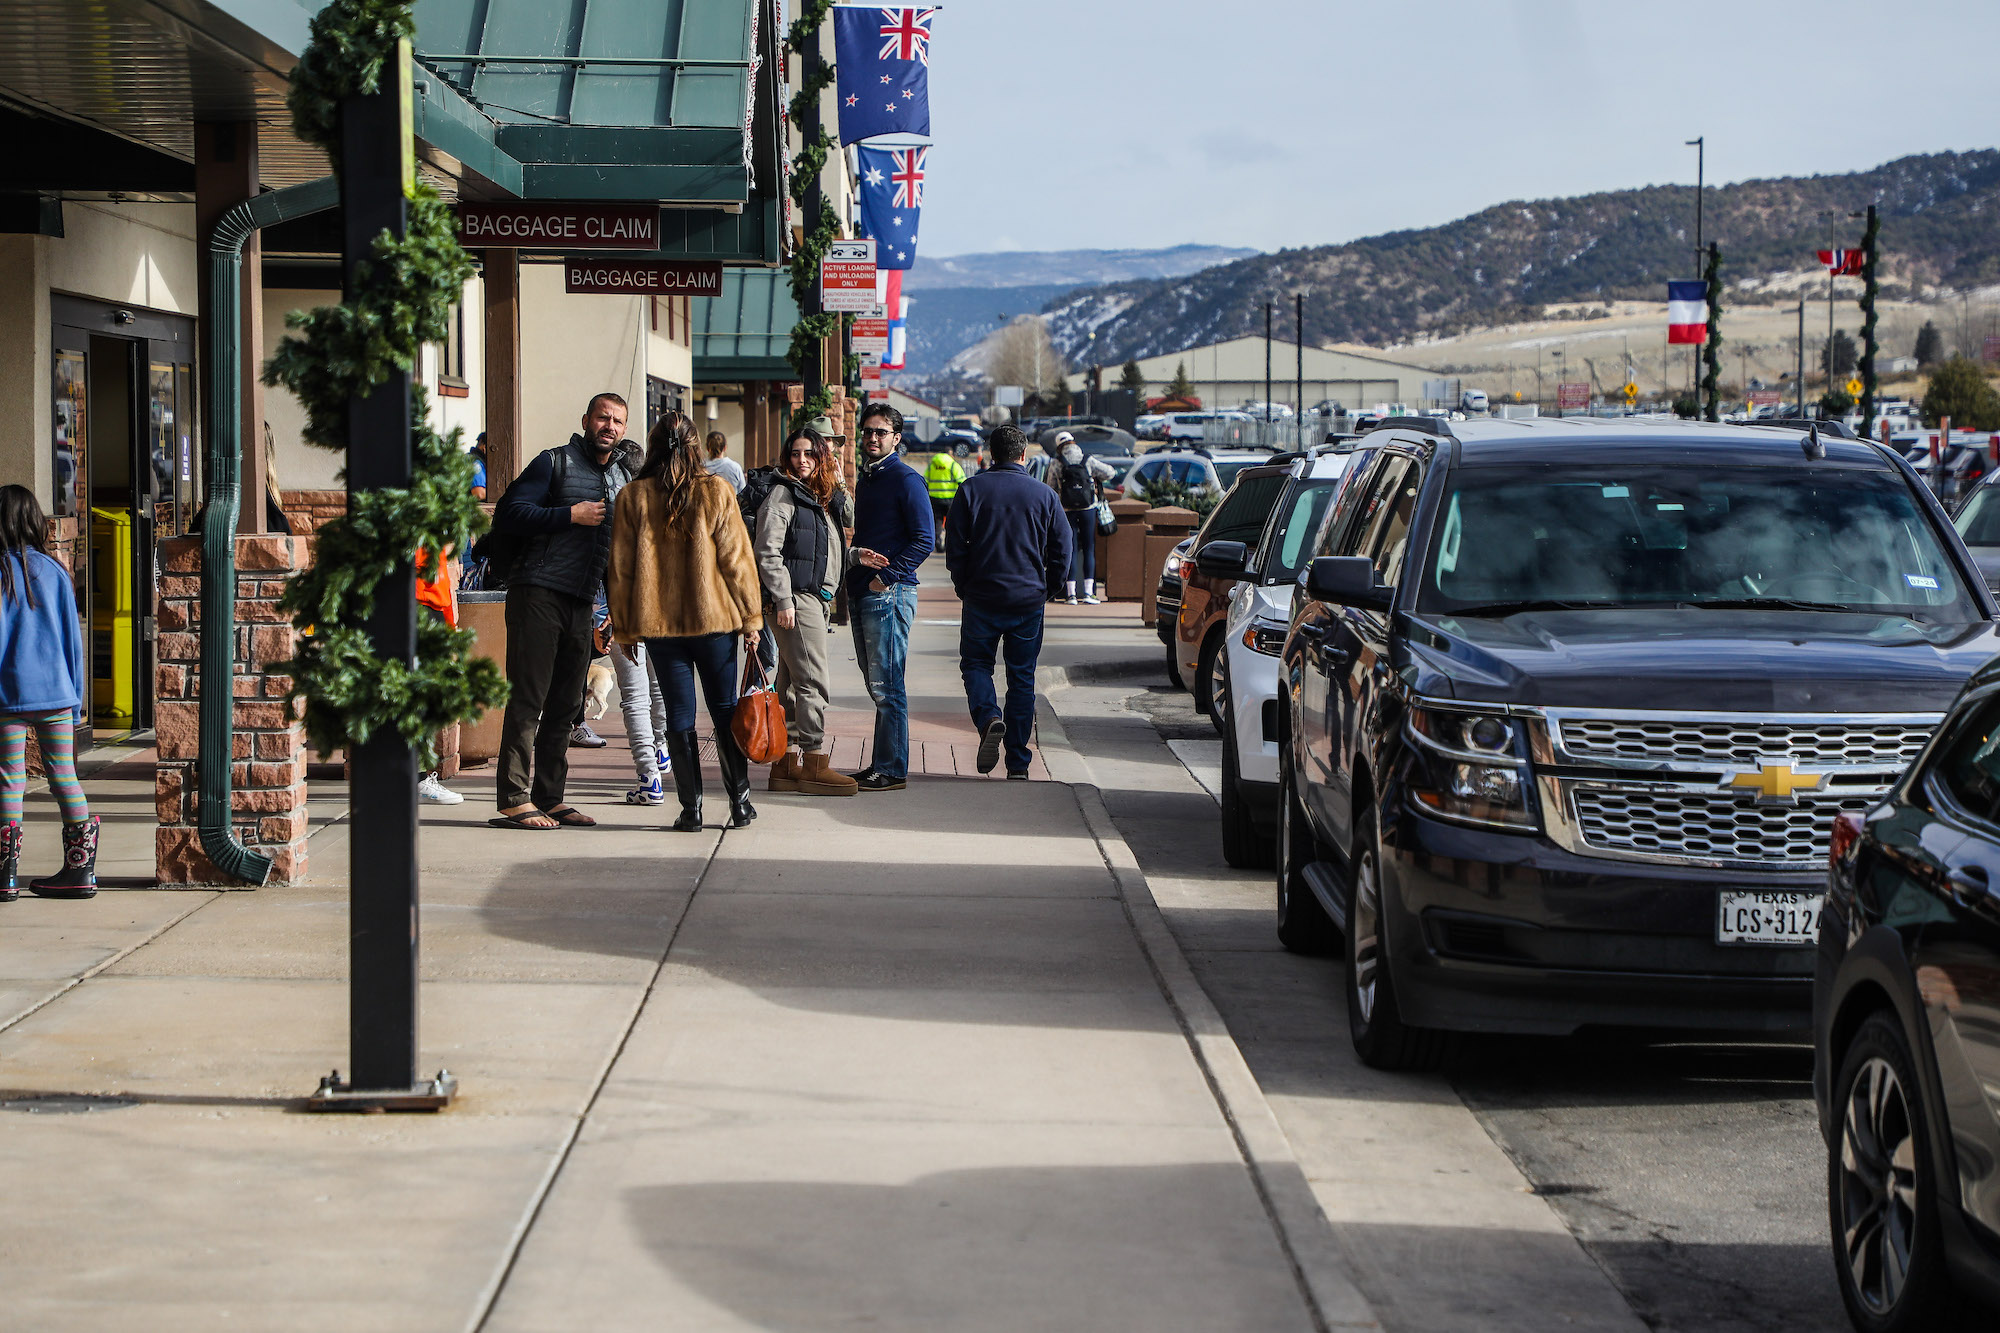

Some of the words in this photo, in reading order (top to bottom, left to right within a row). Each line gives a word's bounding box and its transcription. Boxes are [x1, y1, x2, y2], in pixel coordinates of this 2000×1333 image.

[465, 214, 577, 238] BAGGAGE
[584, 216, 652, 239] CLAIM
[571, 268, 659, 287] BAGGAGE
[662, 270, 717, 289] CLAIM
[1753, 893, 1798, 904] TEXAS
